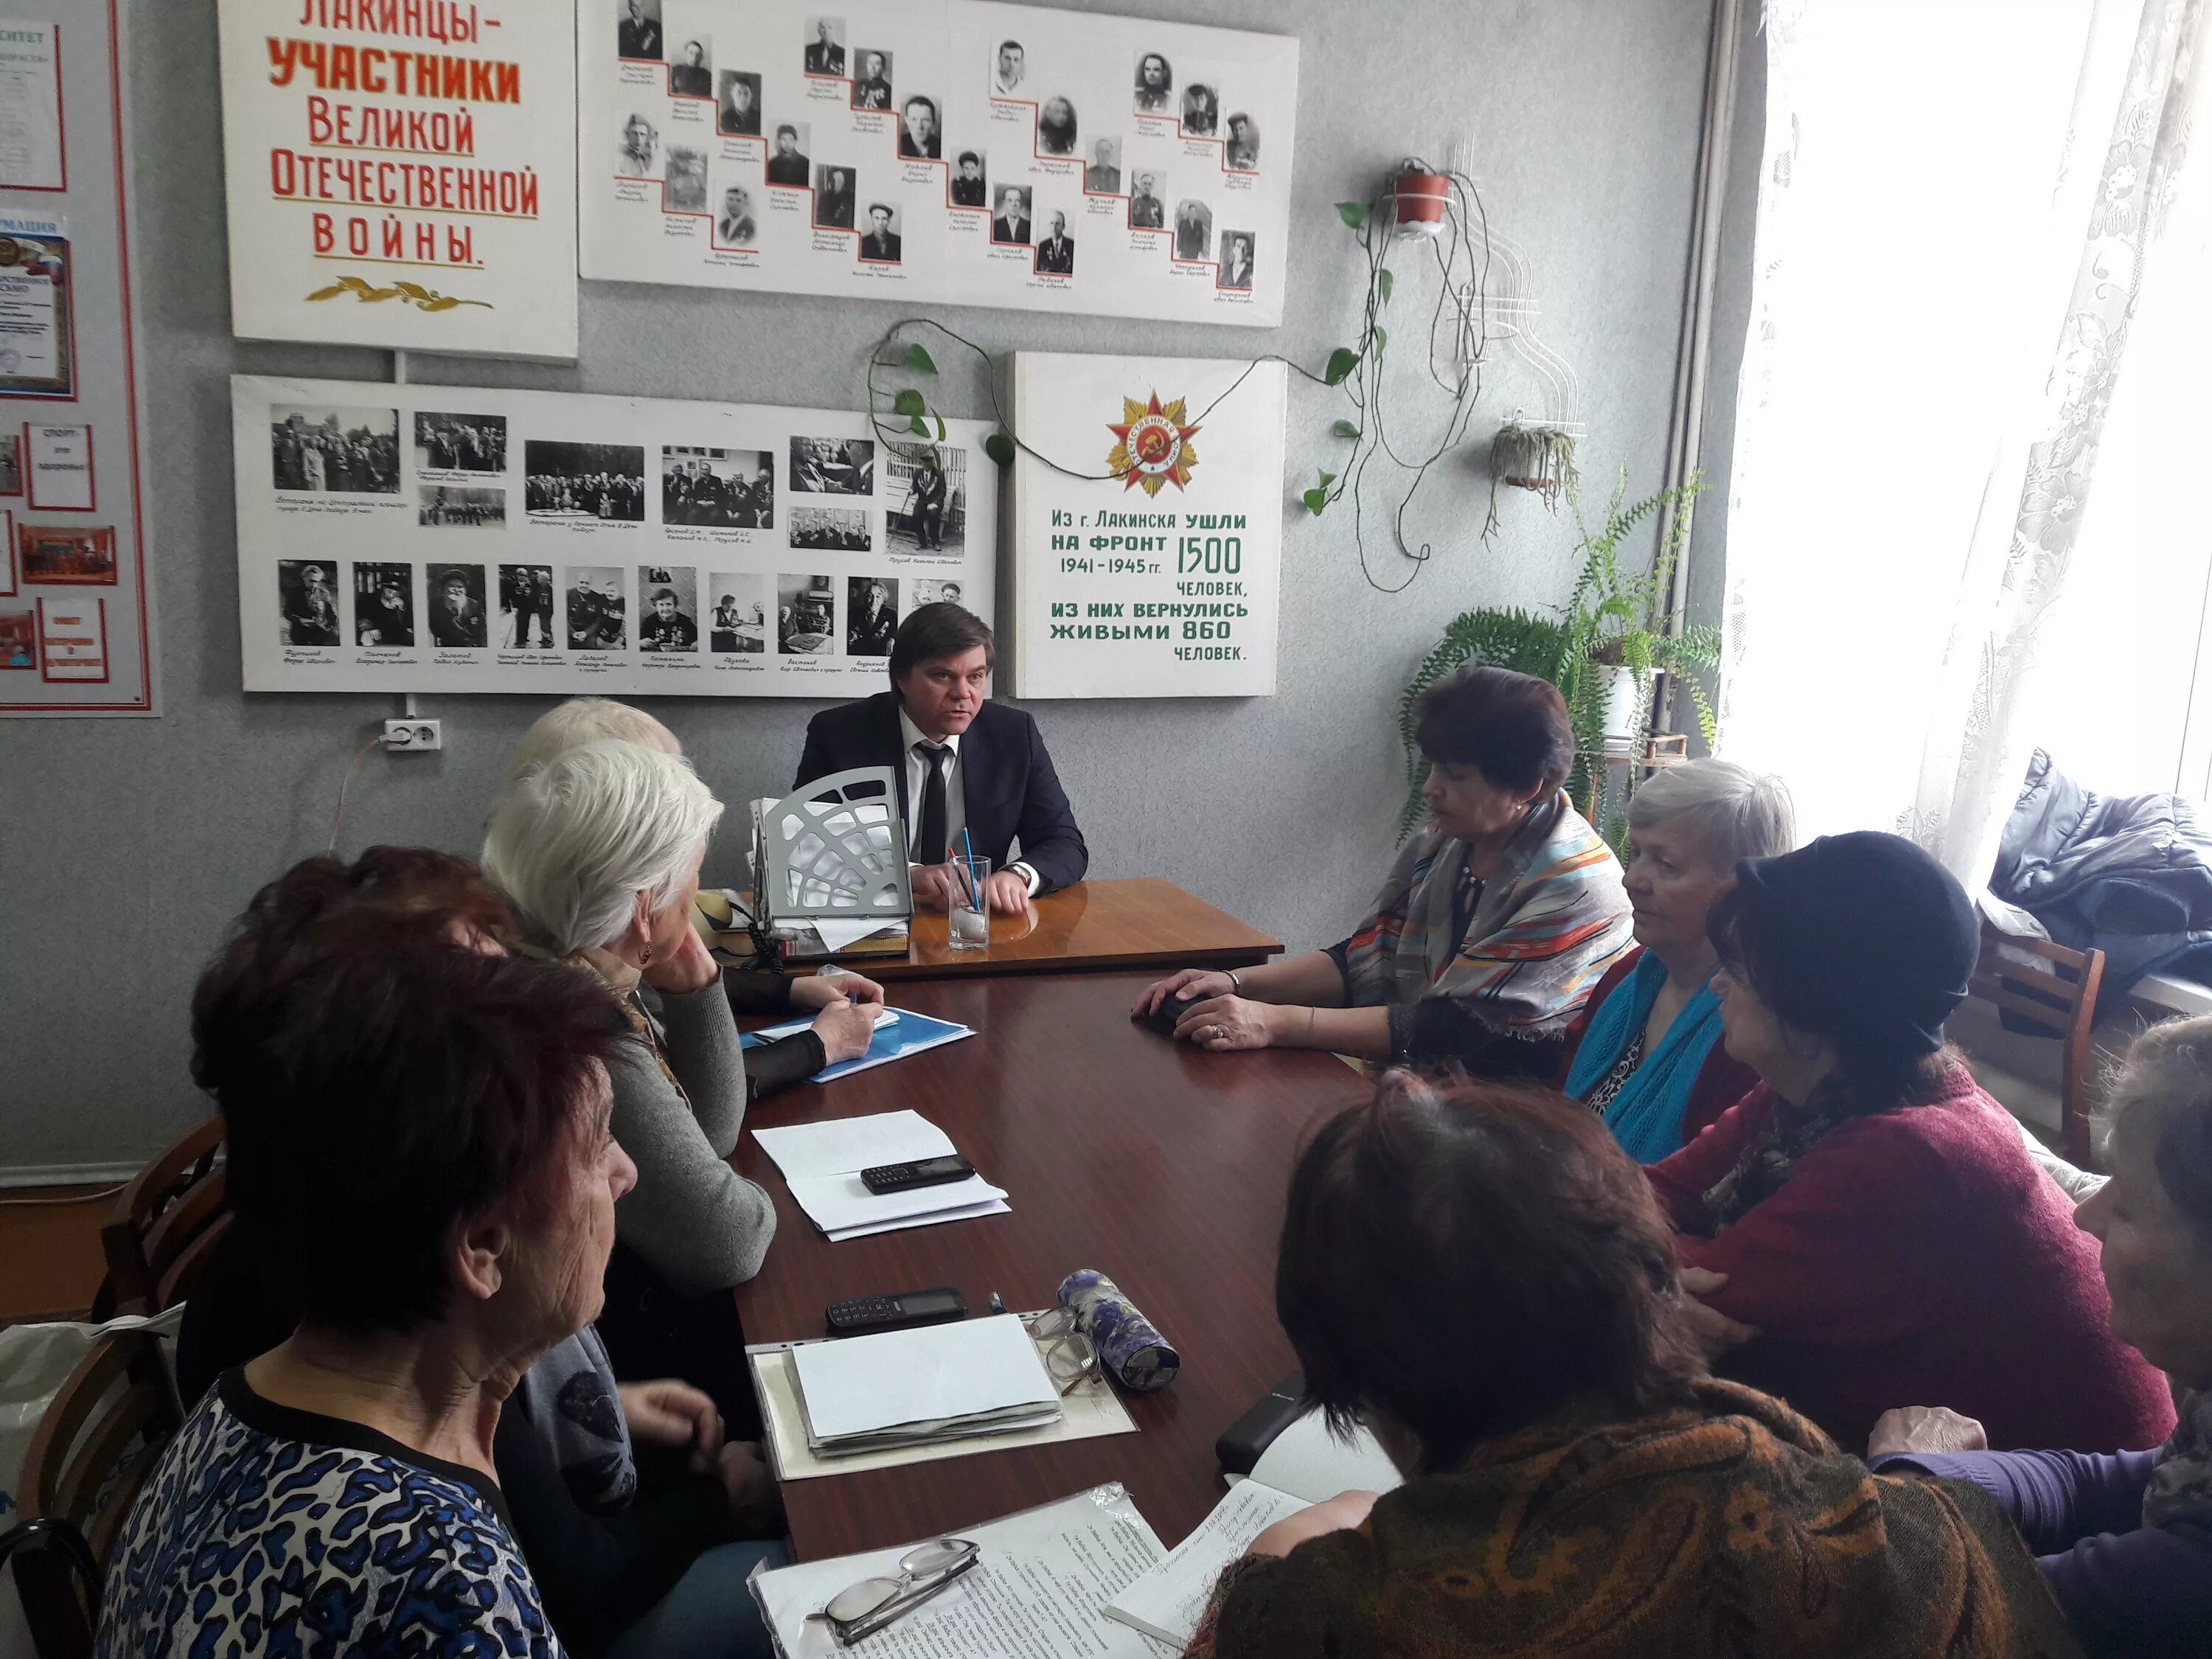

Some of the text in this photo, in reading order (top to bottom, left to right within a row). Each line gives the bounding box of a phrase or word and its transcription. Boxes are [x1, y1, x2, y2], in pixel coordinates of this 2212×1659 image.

[266, 37, 521, 103] УЧАСТНИКИ
[307, 95, 474, 153] ВЕЛИКОЙ
[271, 148, 539, 215] ОТЕЧЕСТВЕННОЙ
[313, 212, 484, 265] ВОЙНЫ.
[1095, 510, 1176, 529] ЛАКИНСКА
[1186, 514, 1247, 529] УШЛИ
[1051, 534, 1242, 574] НА ФРОНТ 1500
[1177, 582, 1248, 597] ЧЕЛОВЕК,
[1051, 603, 1248, 618] ИЗ НИХ ВЕРНУЛИСЬ
[1050, 622, 1231, 640] ЖИВЫМИ 860
[1175, 647, 1248, 661] ЧЕЛОВЕК.
